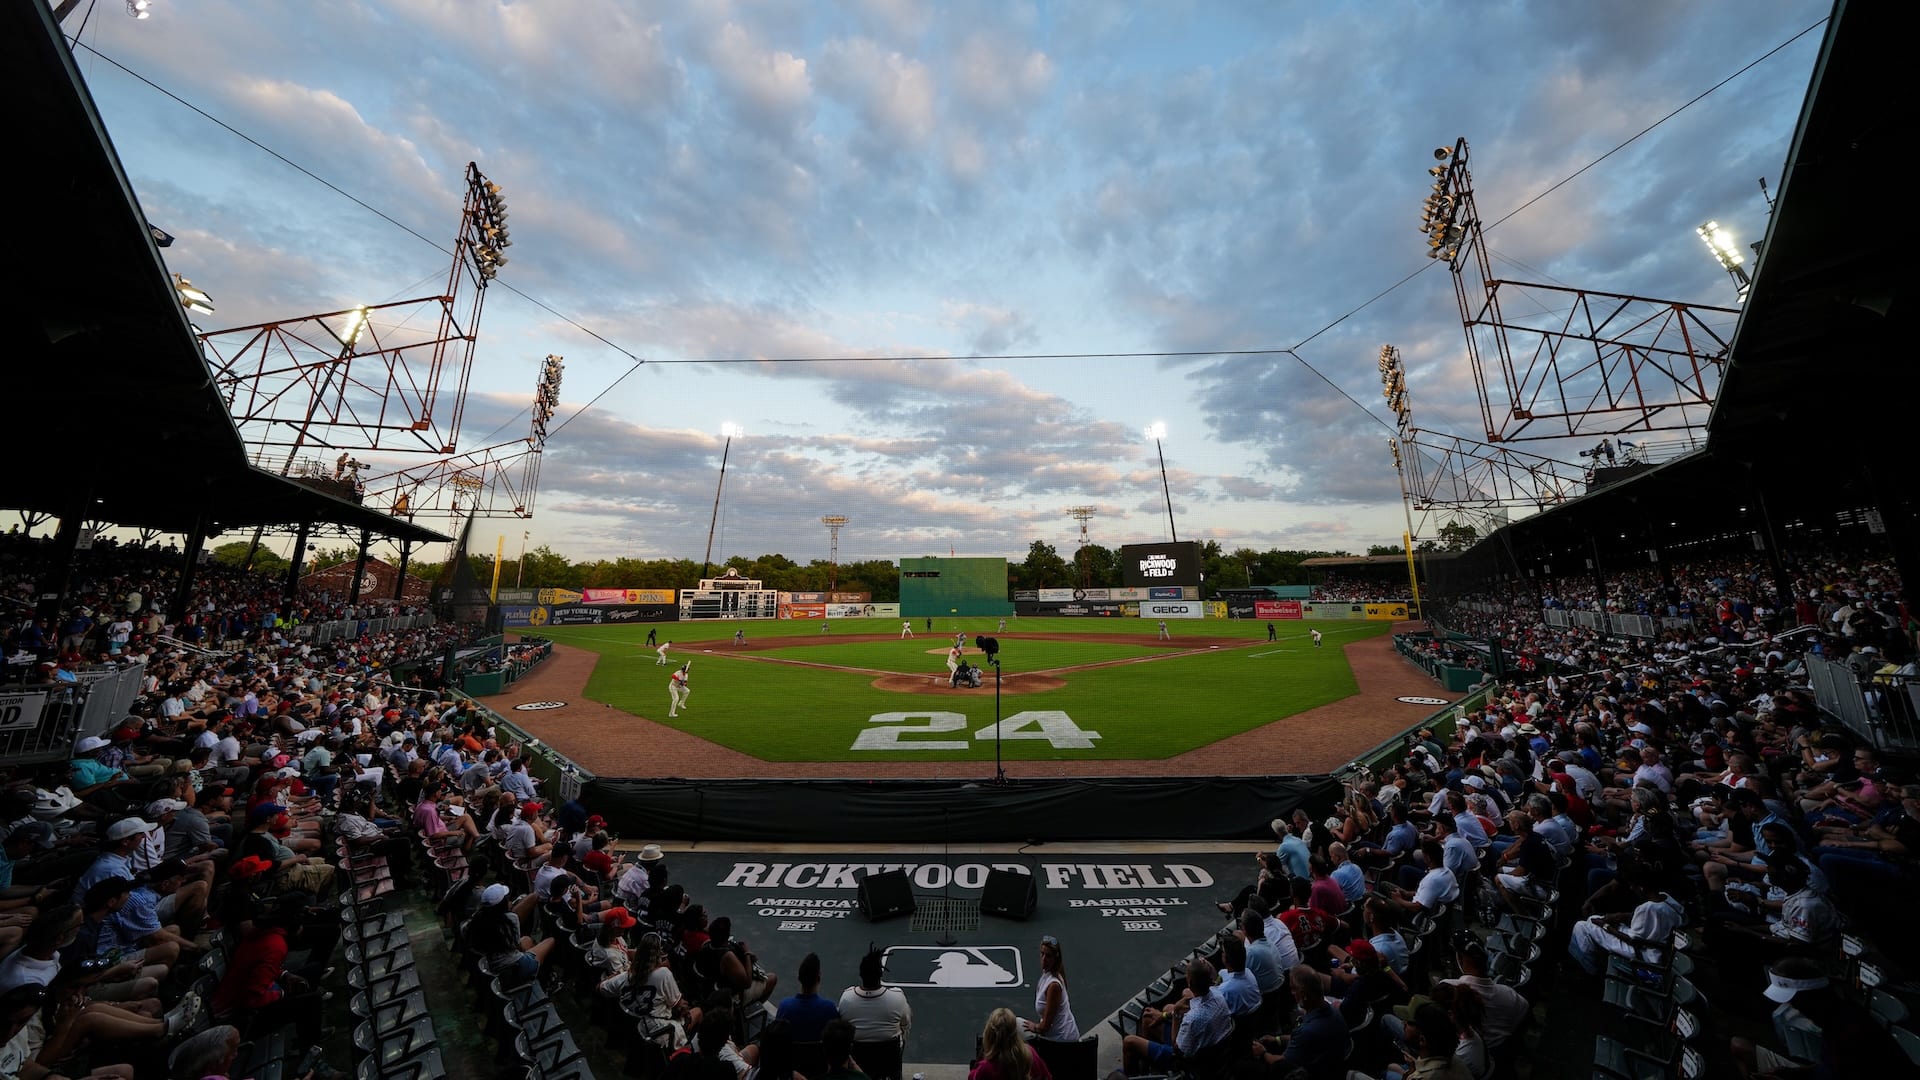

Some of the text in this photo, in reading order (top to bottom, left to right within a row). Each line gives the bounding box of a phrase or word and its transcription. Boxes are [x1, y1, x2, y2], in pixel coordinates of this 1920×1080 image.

[1139, 559, 1176, 572] RICKWOOD
[1149, 568, 1168, 577] FIELD
[570, 608, 588, 616] YORK
[588, 608, 603, 616] LIFE
[1153, 606, 1188, 614] GEICO
[850, 710, 1103, 750] 24
[1040, 862, 1216, 889] FIELD
[747, 897, 859, 909] AMERICA'
[1068, 897, 1189, 908] BASEBALL
[757, 908, 851, 919] OLDEST
[1100, 908, 1167, 918] PARK
[1122, 920, 1162, 931] 1910
